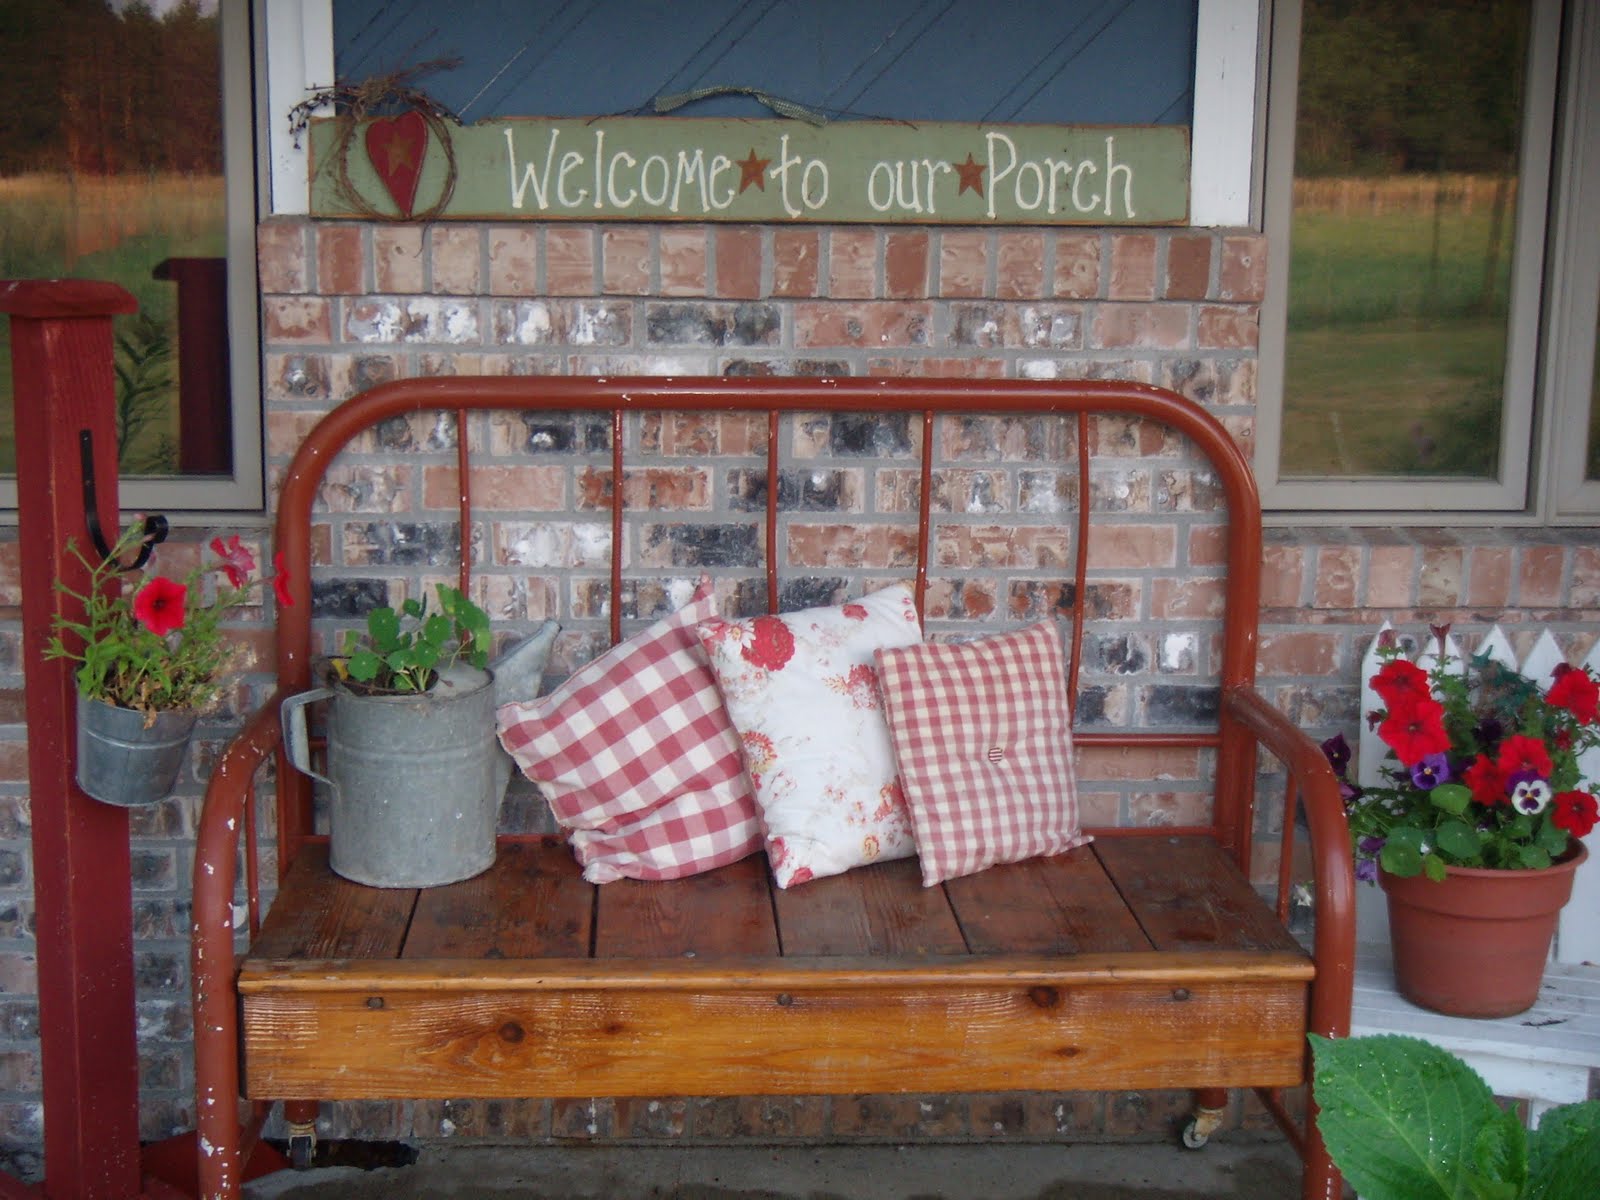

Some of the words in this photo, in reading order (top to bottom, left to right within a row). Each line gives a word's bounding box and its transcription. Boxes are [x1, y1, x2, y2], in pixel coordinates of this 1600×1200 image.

[770, 133, 828, 218] to
[868, 158, 951, 214] our
[986, 132, 1136, 218] Porch
